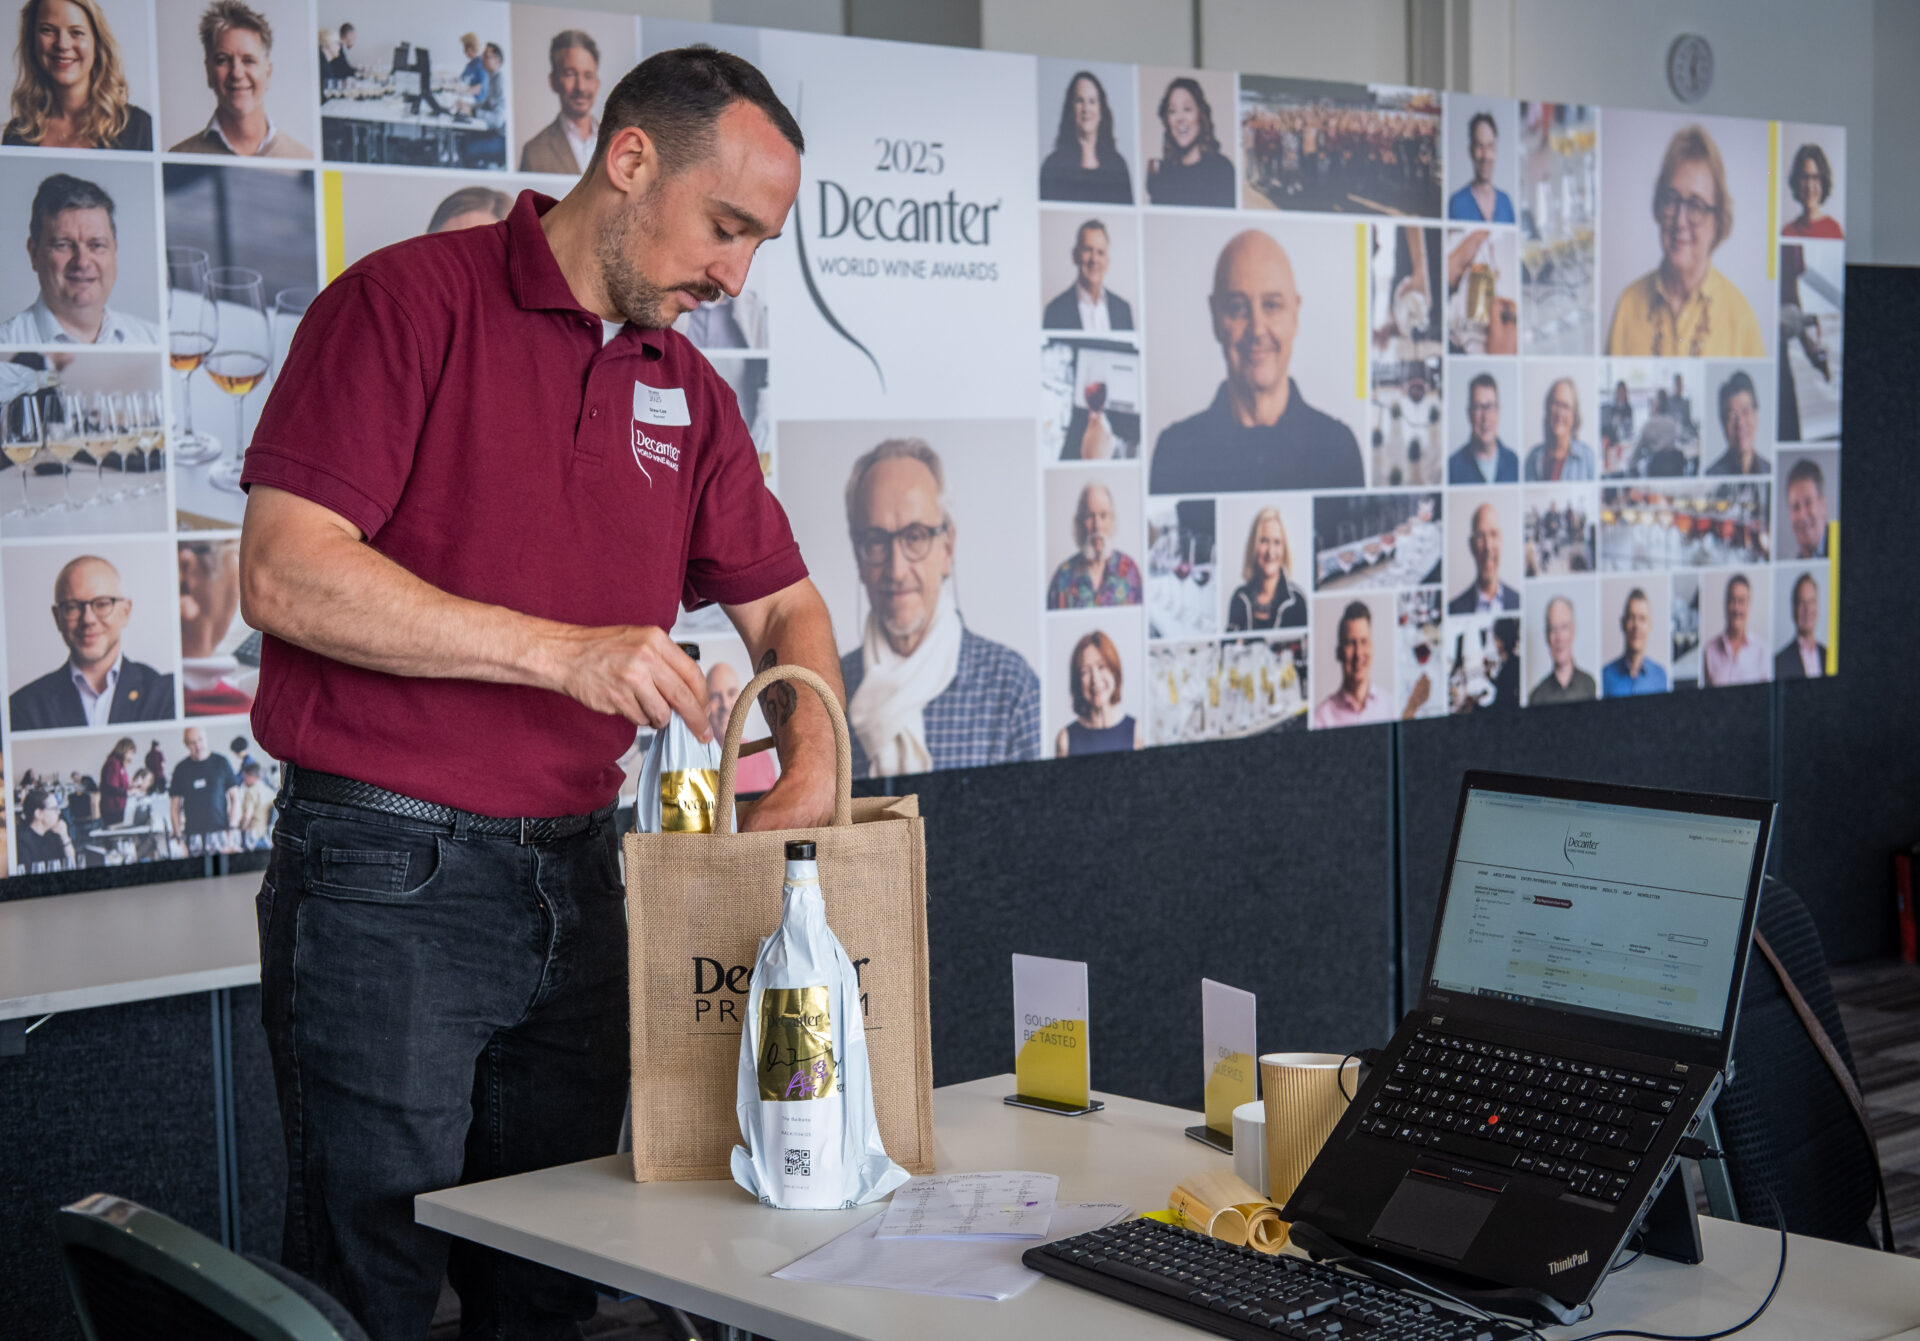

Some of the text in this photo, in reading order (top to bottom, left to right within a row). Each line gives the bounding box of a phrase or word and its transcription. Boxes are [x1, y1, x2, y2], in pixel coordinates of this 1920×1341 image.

[875, 138, 944, 175] 2025
[816, 180, 999, 245] Decanter
[818, 256, 999, 281] WORLD WINE AWARDS
[636, 429, 680, 461] Decanter
[1568, 837, 1599, 850] Decanter
[767, 1012, 821, 1027] Deanter
[1024, 1013, 1075, 1032] GOLDS TO
[1024, 1030, 1077, 1048] BE TASTED
[1218, 1046, 1239, 1063] GOLD
[1547, 1249, 1589, 1276] ThinkPad
